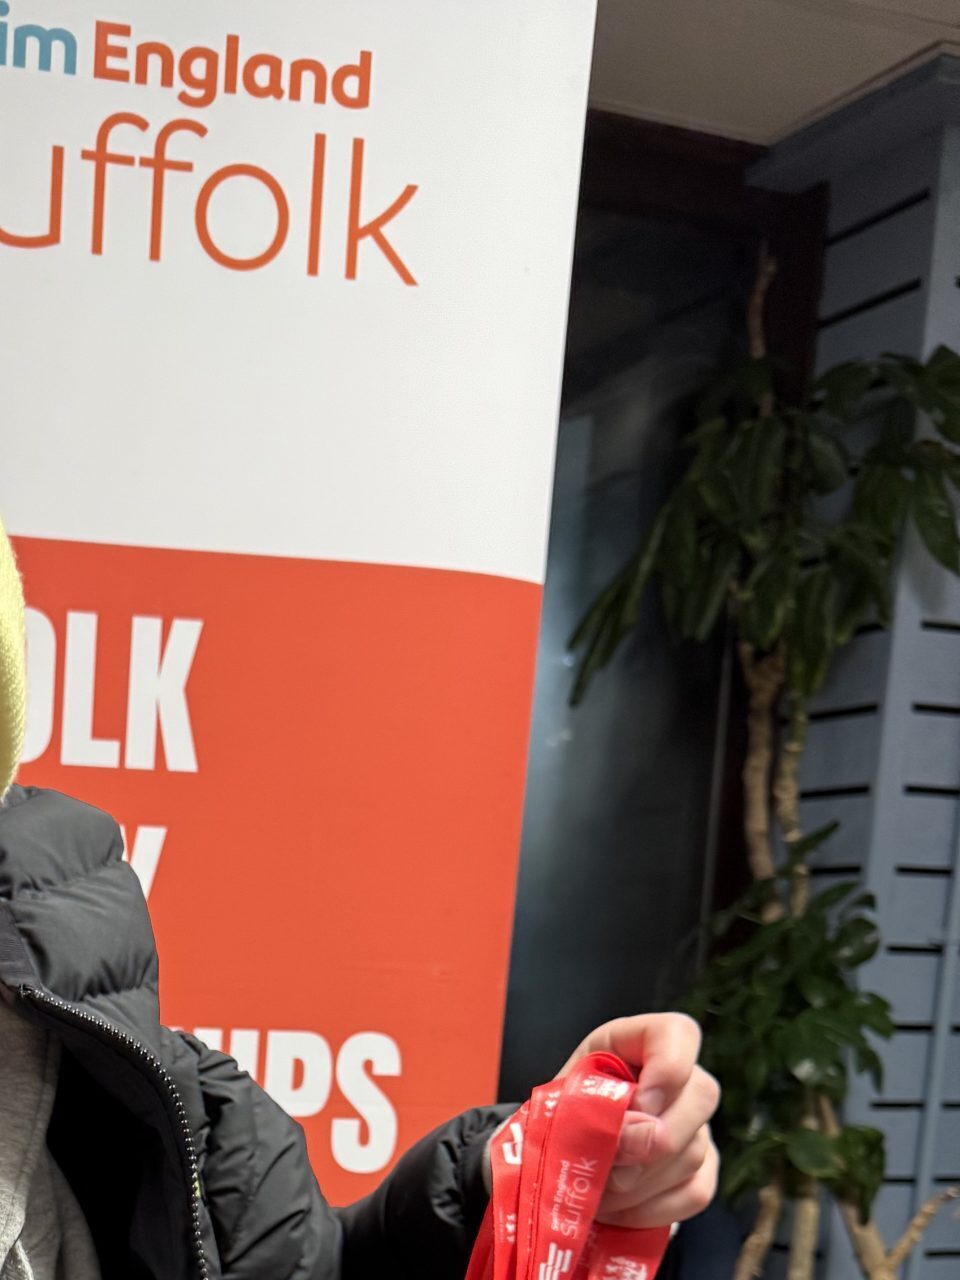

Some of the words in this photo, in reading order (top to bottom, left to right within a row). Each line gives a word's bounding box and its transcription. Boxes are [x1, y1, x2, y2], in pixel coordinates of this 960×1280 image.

[93, 19, 373, 109] England
[552, 1159, 571, 1207] England
[560, 1156, 601, 1240] Suffolk
